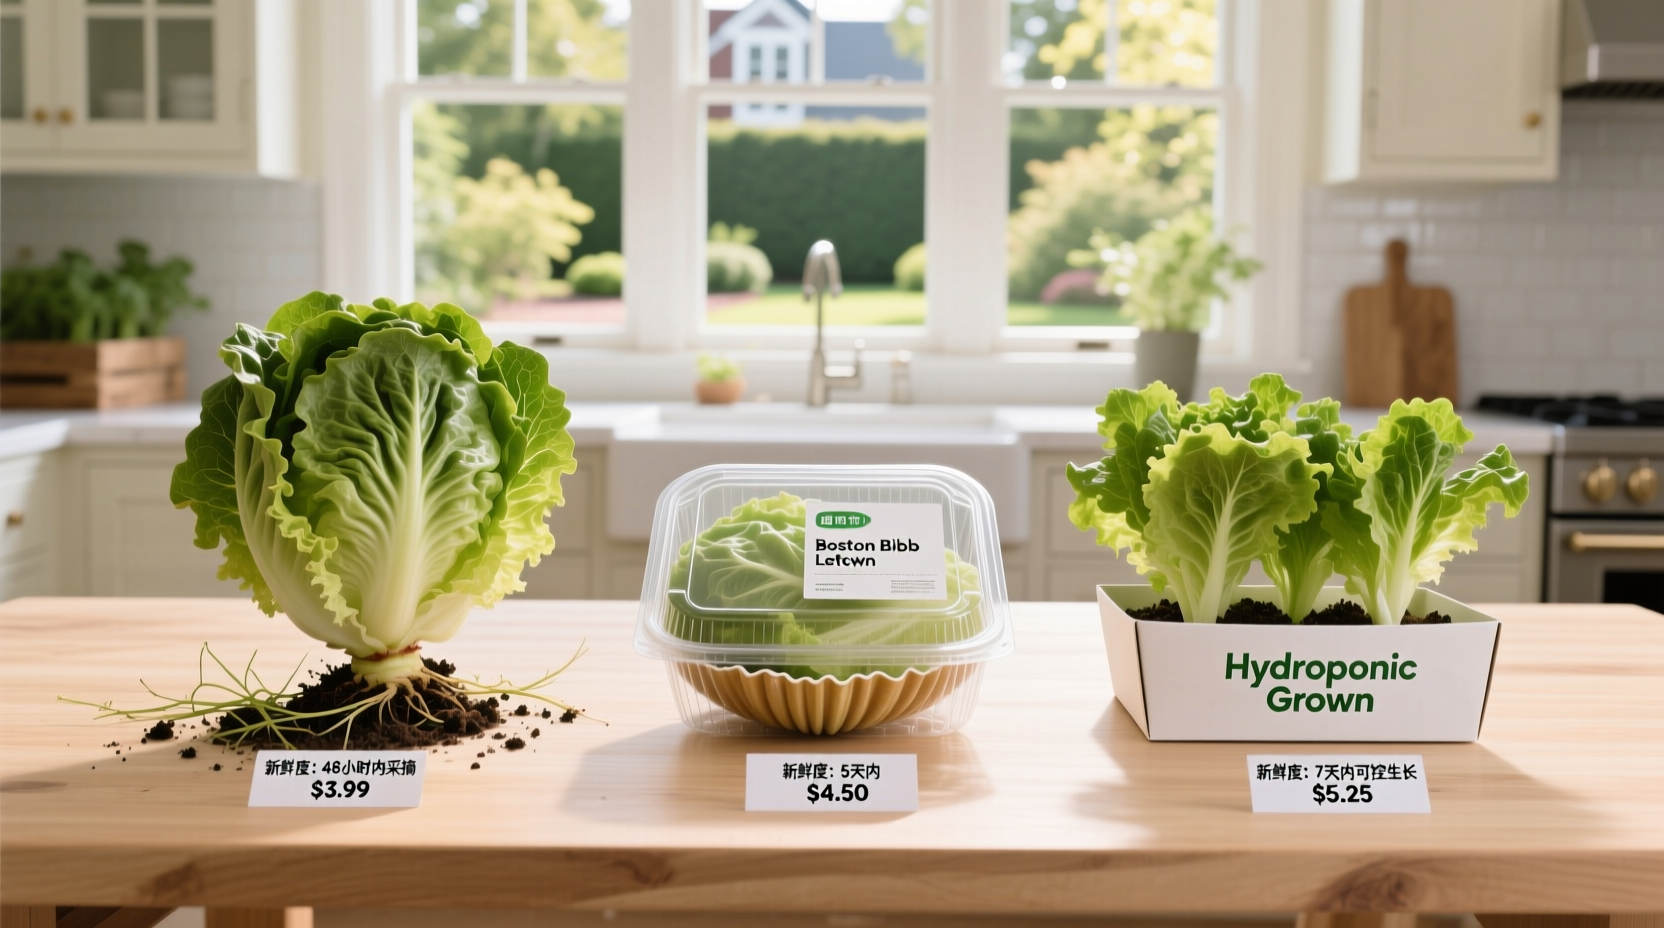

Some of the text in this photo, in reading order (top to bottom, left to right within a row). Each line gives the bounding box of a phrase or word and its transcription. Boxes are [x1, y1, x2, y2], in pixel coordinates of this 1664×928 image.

[815, 538, 876, 552] Boston
[1225, 651, 1418, 689] Hydroponic
[1266, 685, 1374, 713] Grown
[310, 779, 370, 801] $3.99
[806, 782, 869, 805] $4.50
[1312, 782, 1374, 806] $5.25
